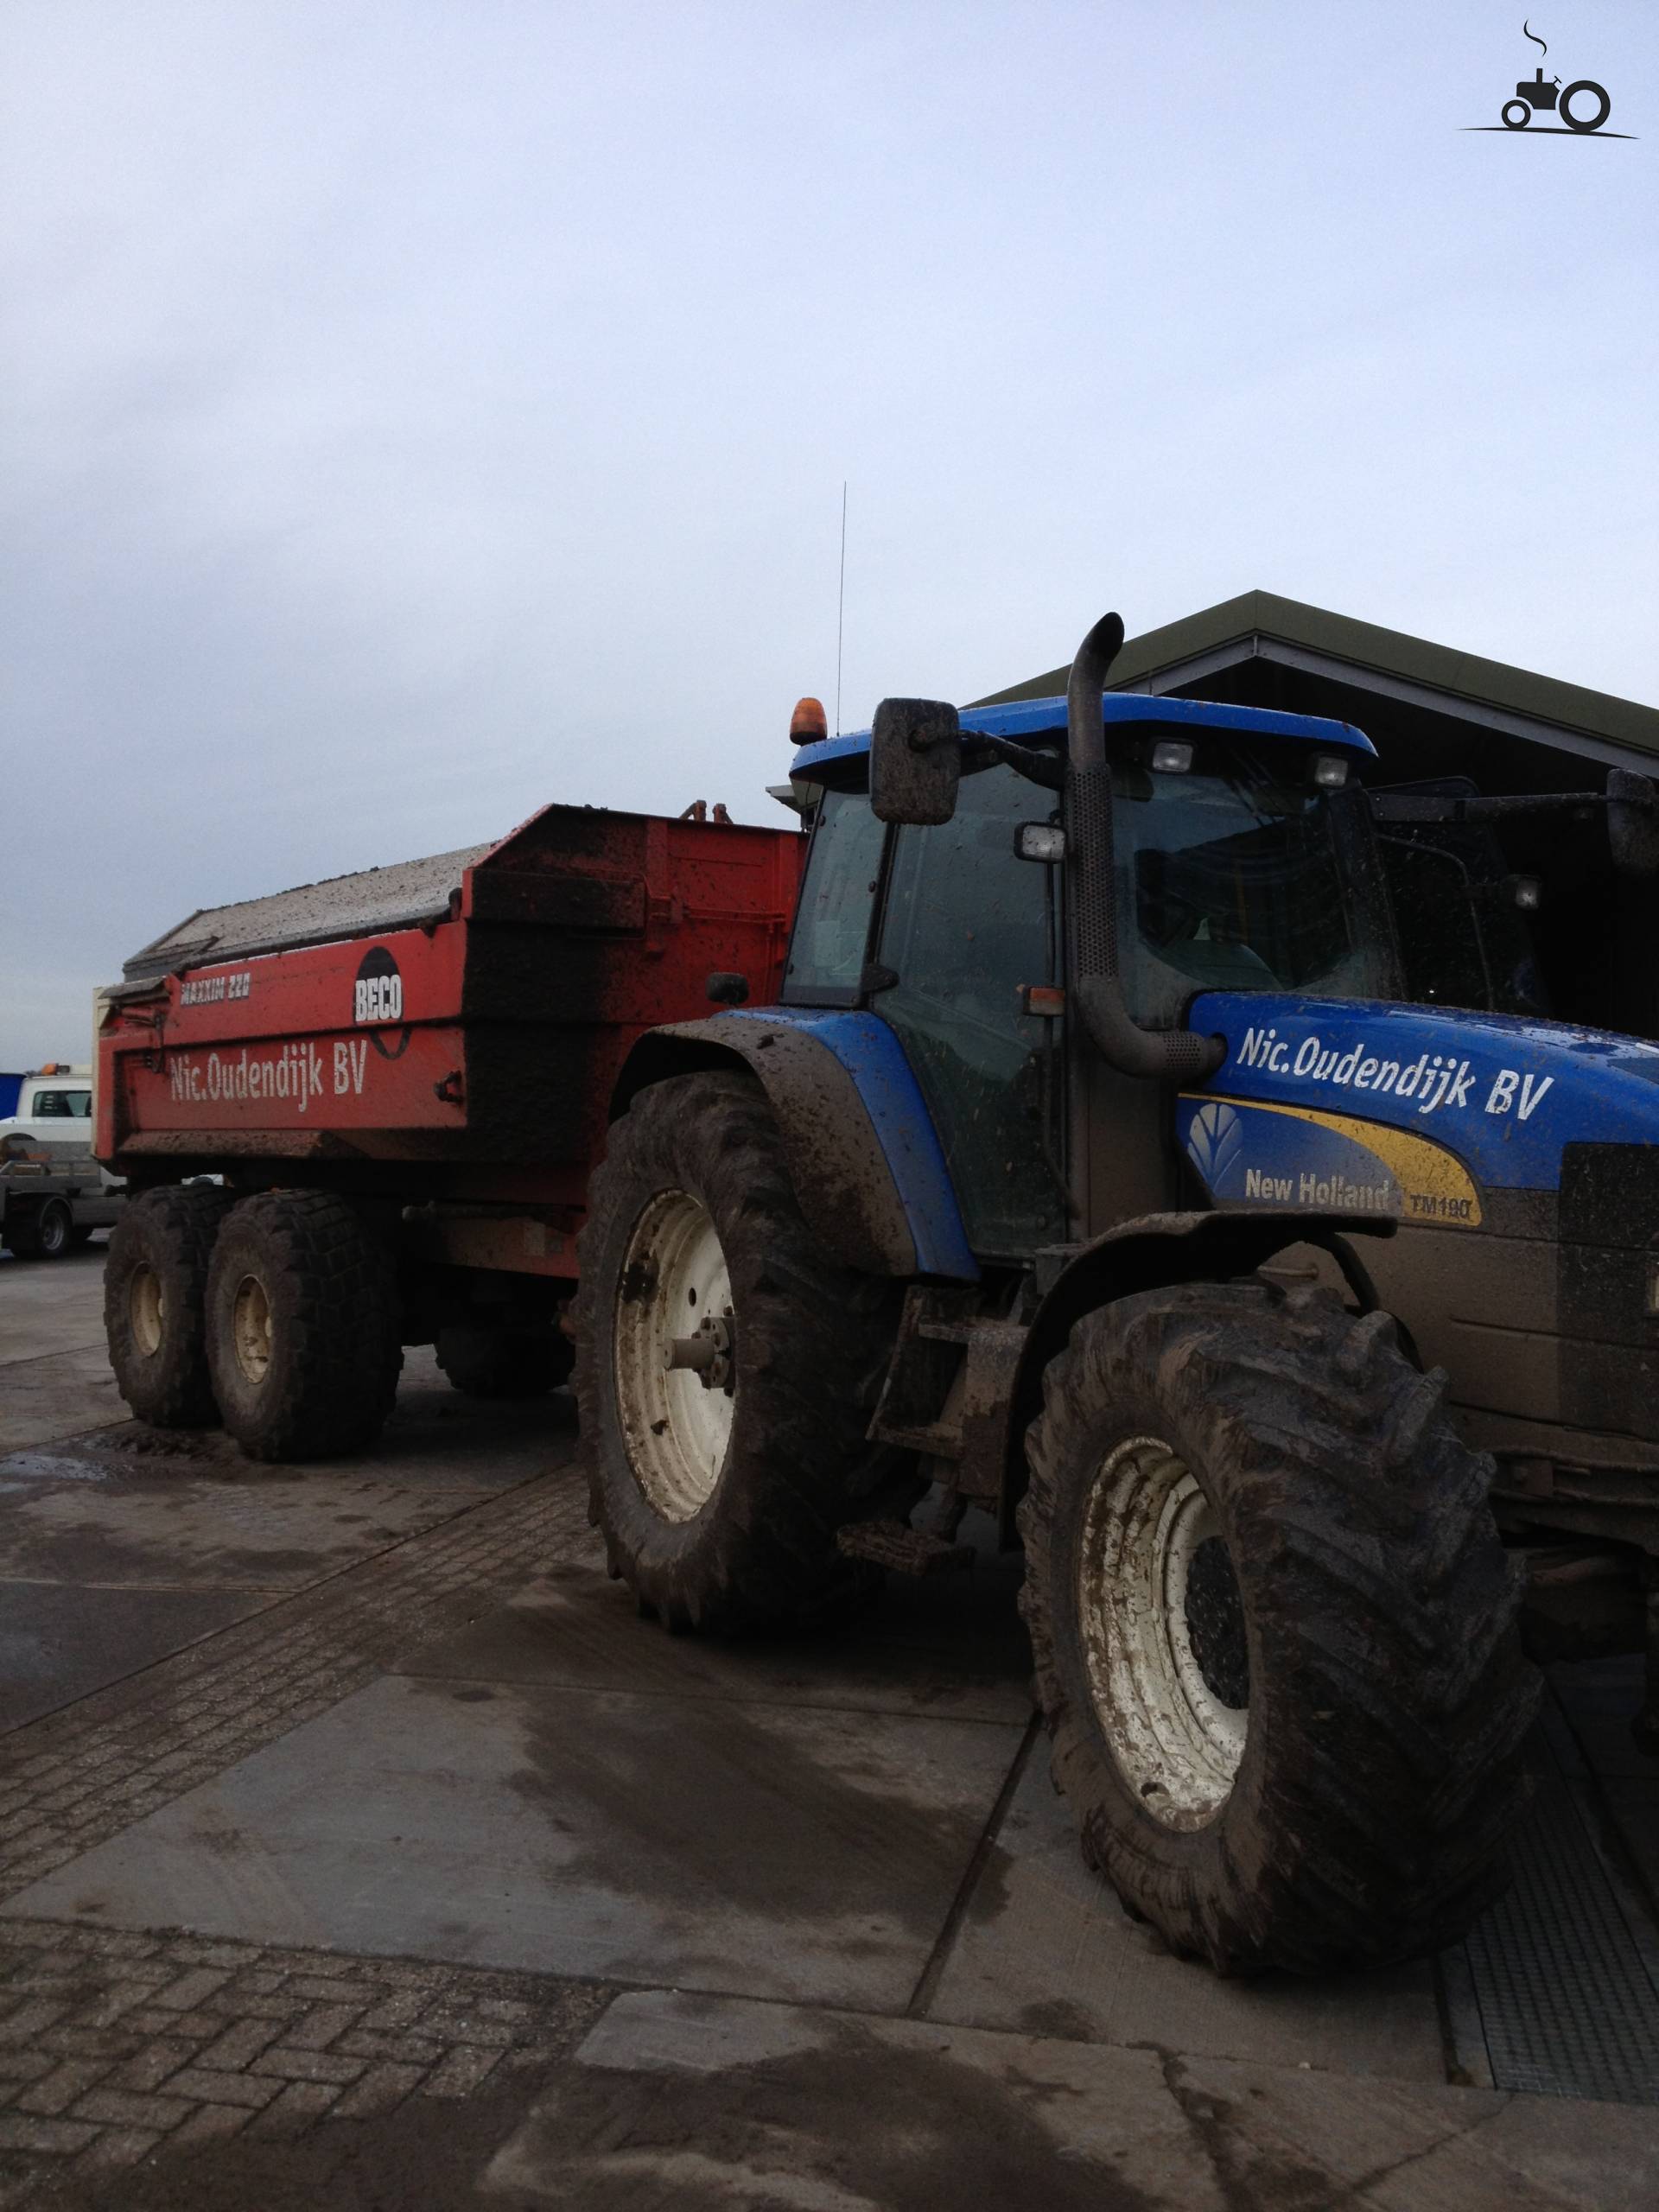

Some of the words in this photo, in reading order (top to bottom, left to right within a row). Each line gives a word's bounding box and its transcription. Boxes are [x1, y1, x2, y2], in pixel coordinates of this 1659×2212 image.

[227, 972, 251, 1000] 220
[354, 974, 403, 1023] BECO
[171, 1043, 323, 1114] Nic.Oudendijk
[334, 1039, 368, 1096] BV
[1236, 1027, 1476, 1115] Nic.Oudendijk
[1484, 1069, 1556, 1121] BV
[1245, 1168, 1294, 1202] New
[1298, 1171, 1391, 1211] Holland
